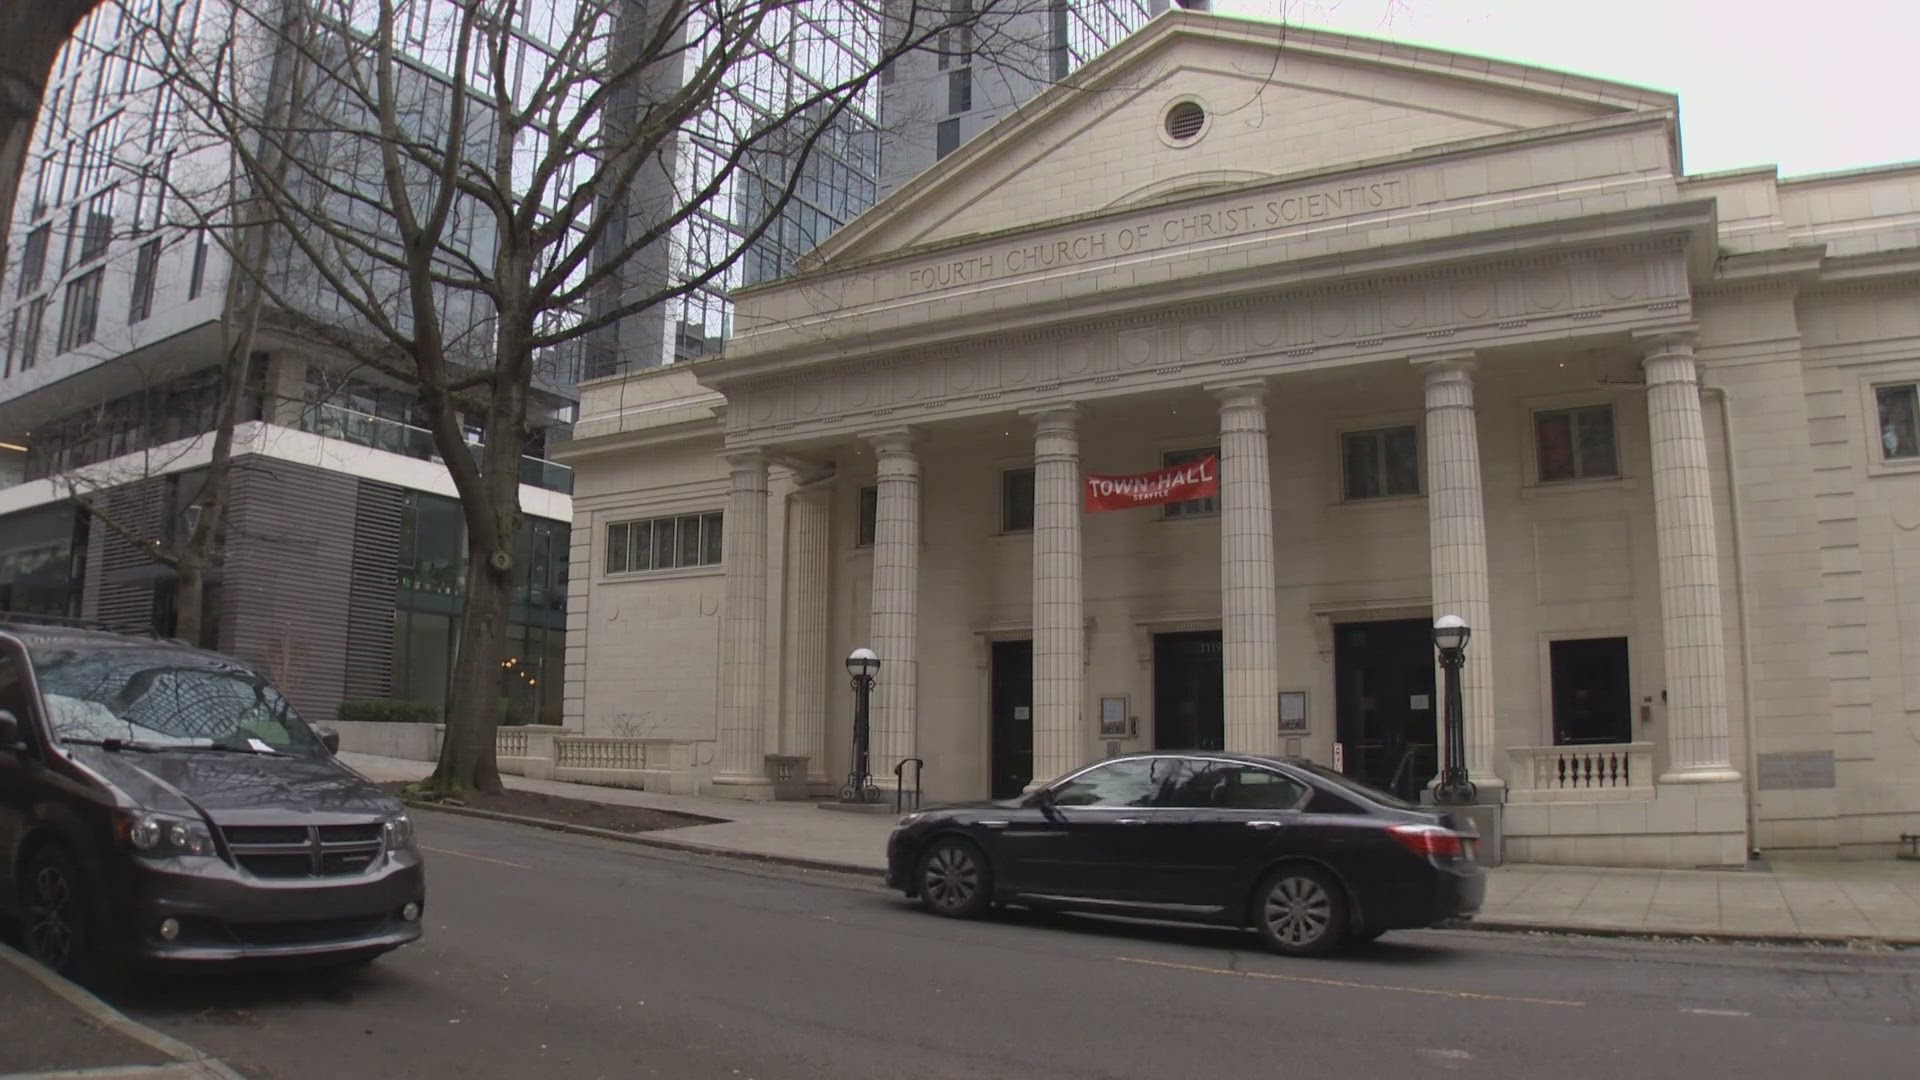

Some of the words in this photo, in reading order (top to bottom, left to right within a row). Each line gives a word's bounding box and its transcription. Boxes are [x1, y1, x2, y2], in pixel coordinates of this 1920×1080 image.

[909, 255, 993, 291] FOURTH
[1006, 233, 1106, 272] CHURCH
[1118, 225, 1150, 251] OF
[1265, 180, 1400, 225] SCIENTIST
[1089, 478, 1148, 497] TOWN
[1157, 464, 1213, 490] HALL
[1133, 490, 1169, 501] SEATTLE
